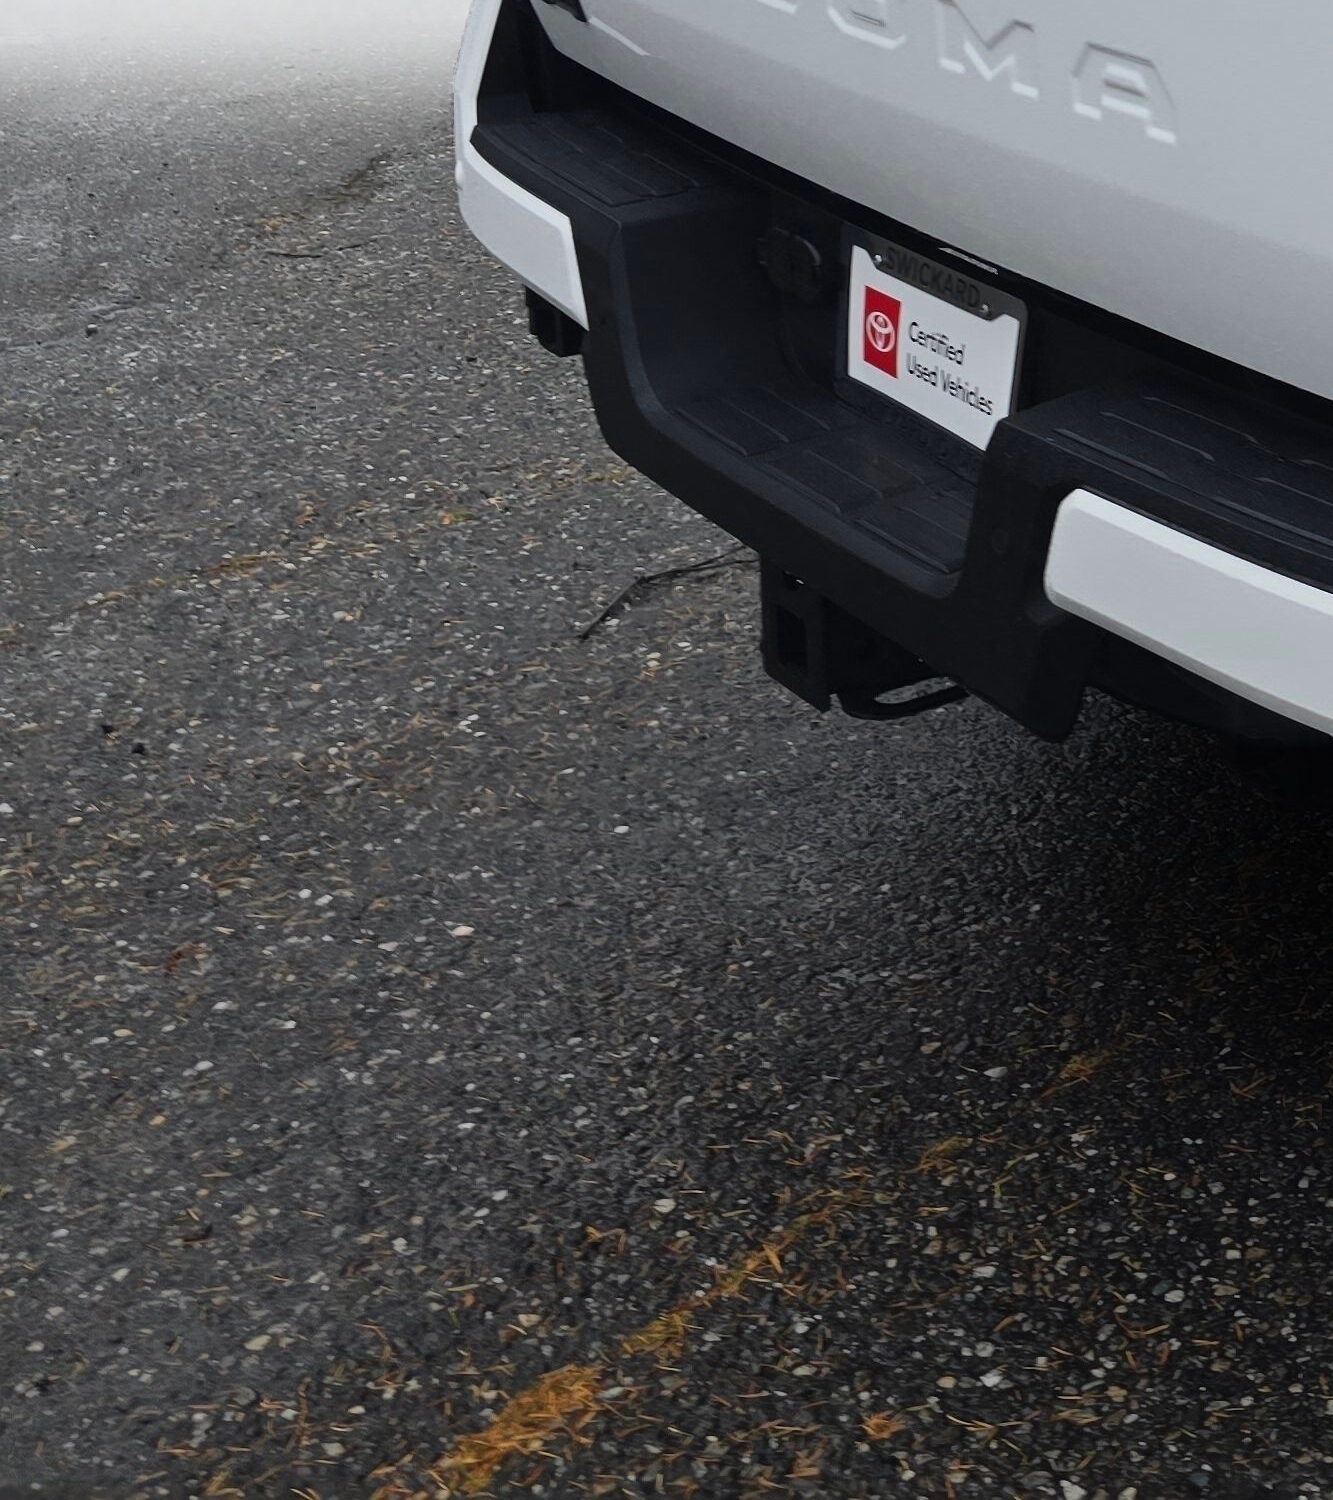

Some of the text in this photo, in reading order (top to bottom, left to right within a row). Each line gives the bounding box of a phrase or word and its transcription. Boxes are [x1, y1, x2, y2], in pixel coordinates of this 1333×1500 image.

[884, 248, 981, 308] SWICKARD
[908, 321, 966, 365] Certified
[906, 353, 993, 416] Used Vehicles
